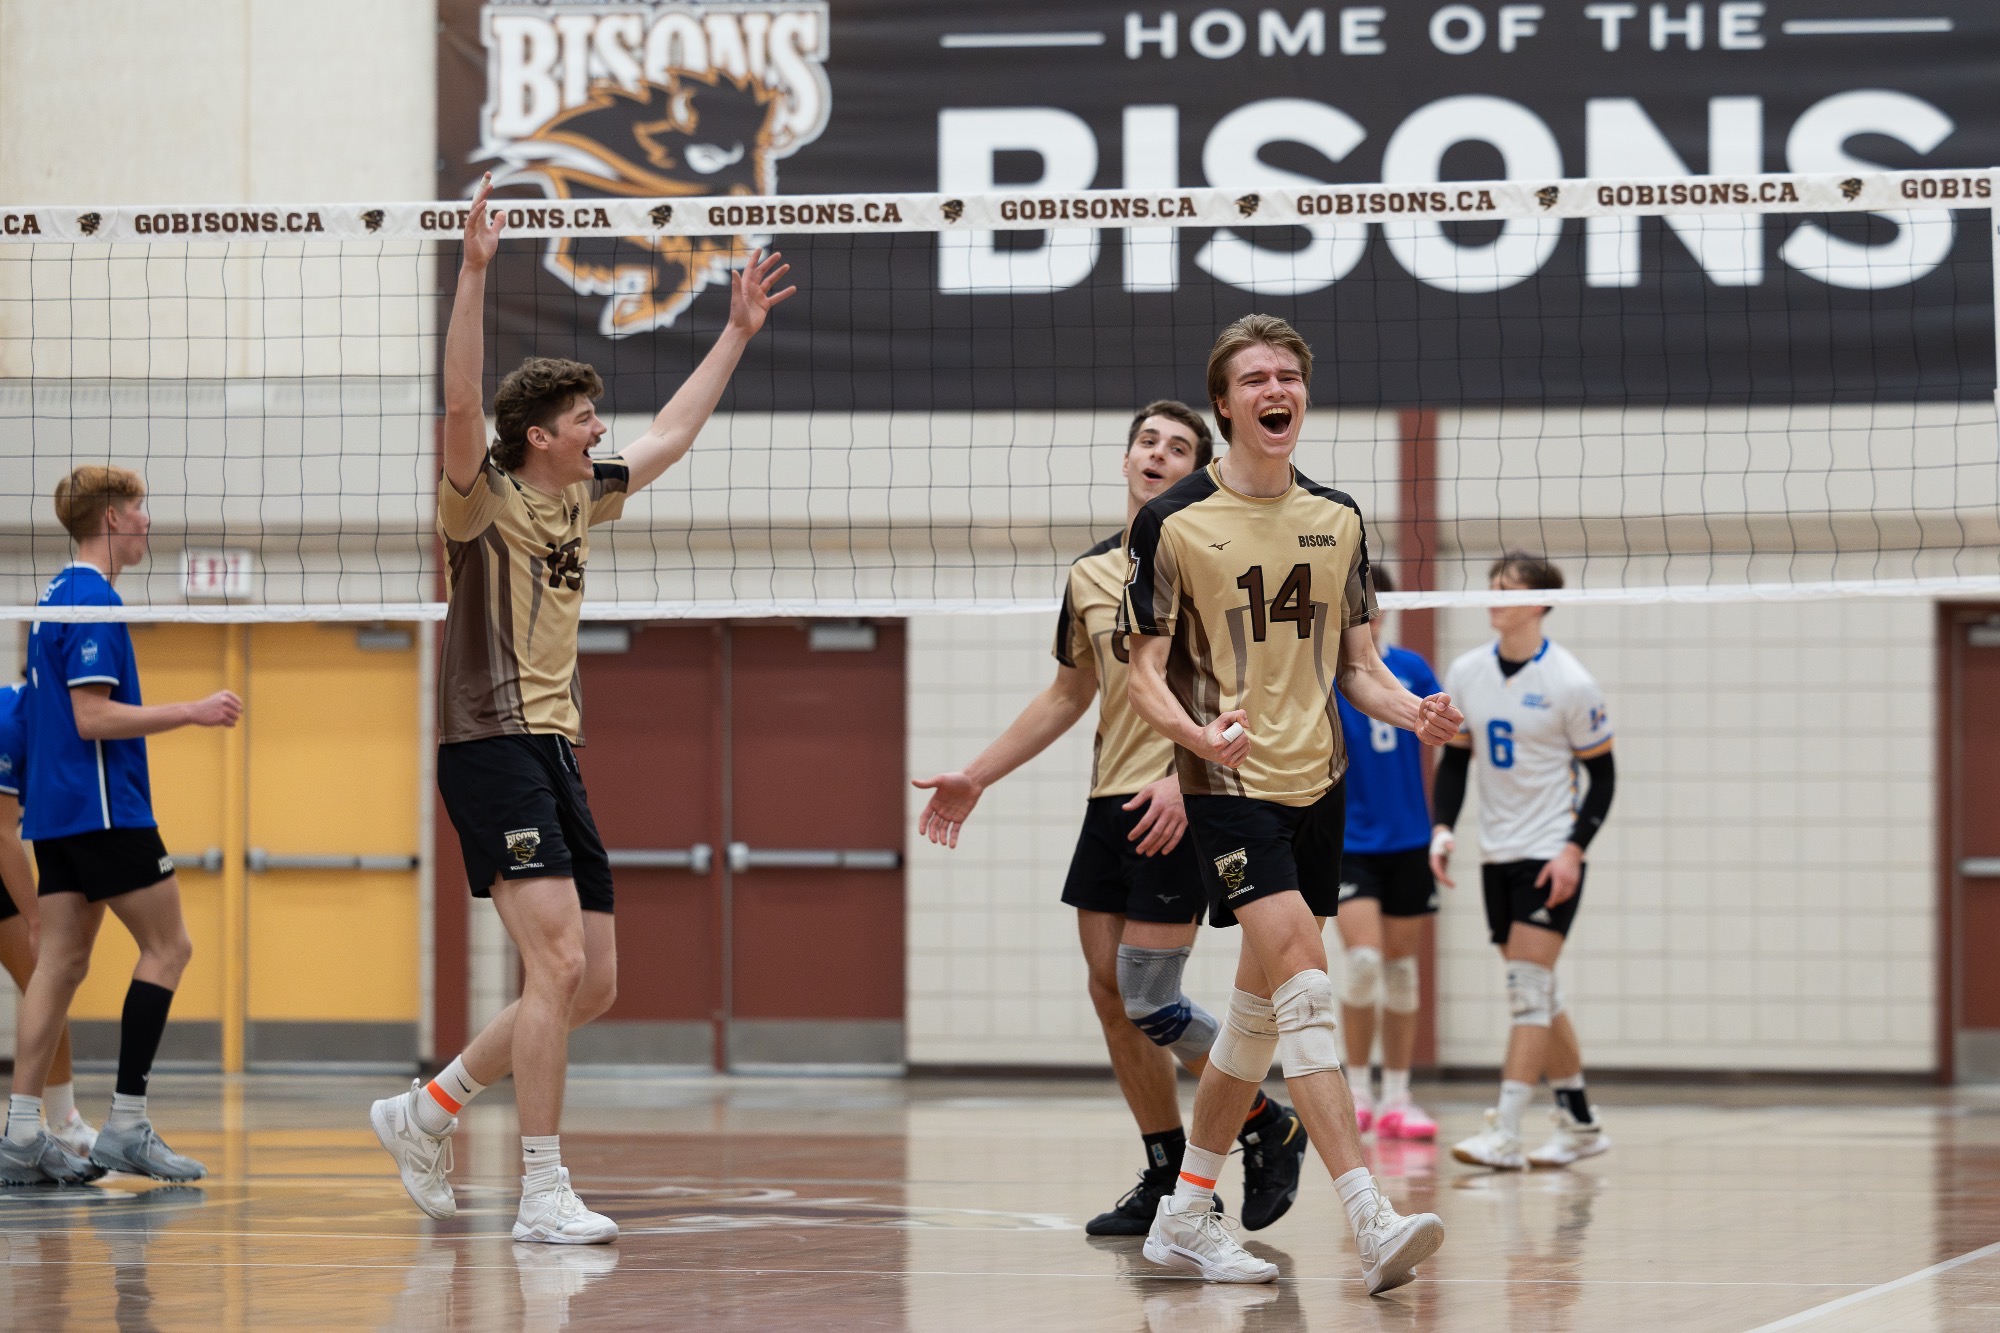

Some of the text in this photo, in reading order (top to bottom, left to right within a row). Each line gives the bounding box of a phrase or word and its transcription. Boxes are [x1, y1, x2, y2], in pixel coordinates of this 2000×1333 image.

[1124, 3, 1765, 59] HOME OF THE
[491, 9, 820, 142] BISONS
[134, 212, 325, 235] GOBISONS.CA
[420, 208, 612, 230] GOBONS.CA
[708, 202, 903, 227] GOBISONS.CA
[1000, 197, 1197, 221] GOBISONS.CA
[1297, 190, 1496, 216] GOBISONS.CA
[1597, 182, 1799, 207] GOBISONS.CA
[1901, 177, 1991, 199] GOBIS
[937, 89, 1957, 295] BISONS
[1297, 534, 1337, 548] BISONS
[1236, 563, 1316, 643] 14
[1487, 719, 1515, 769] 6
[505, 831, 541, 849] BISONS
